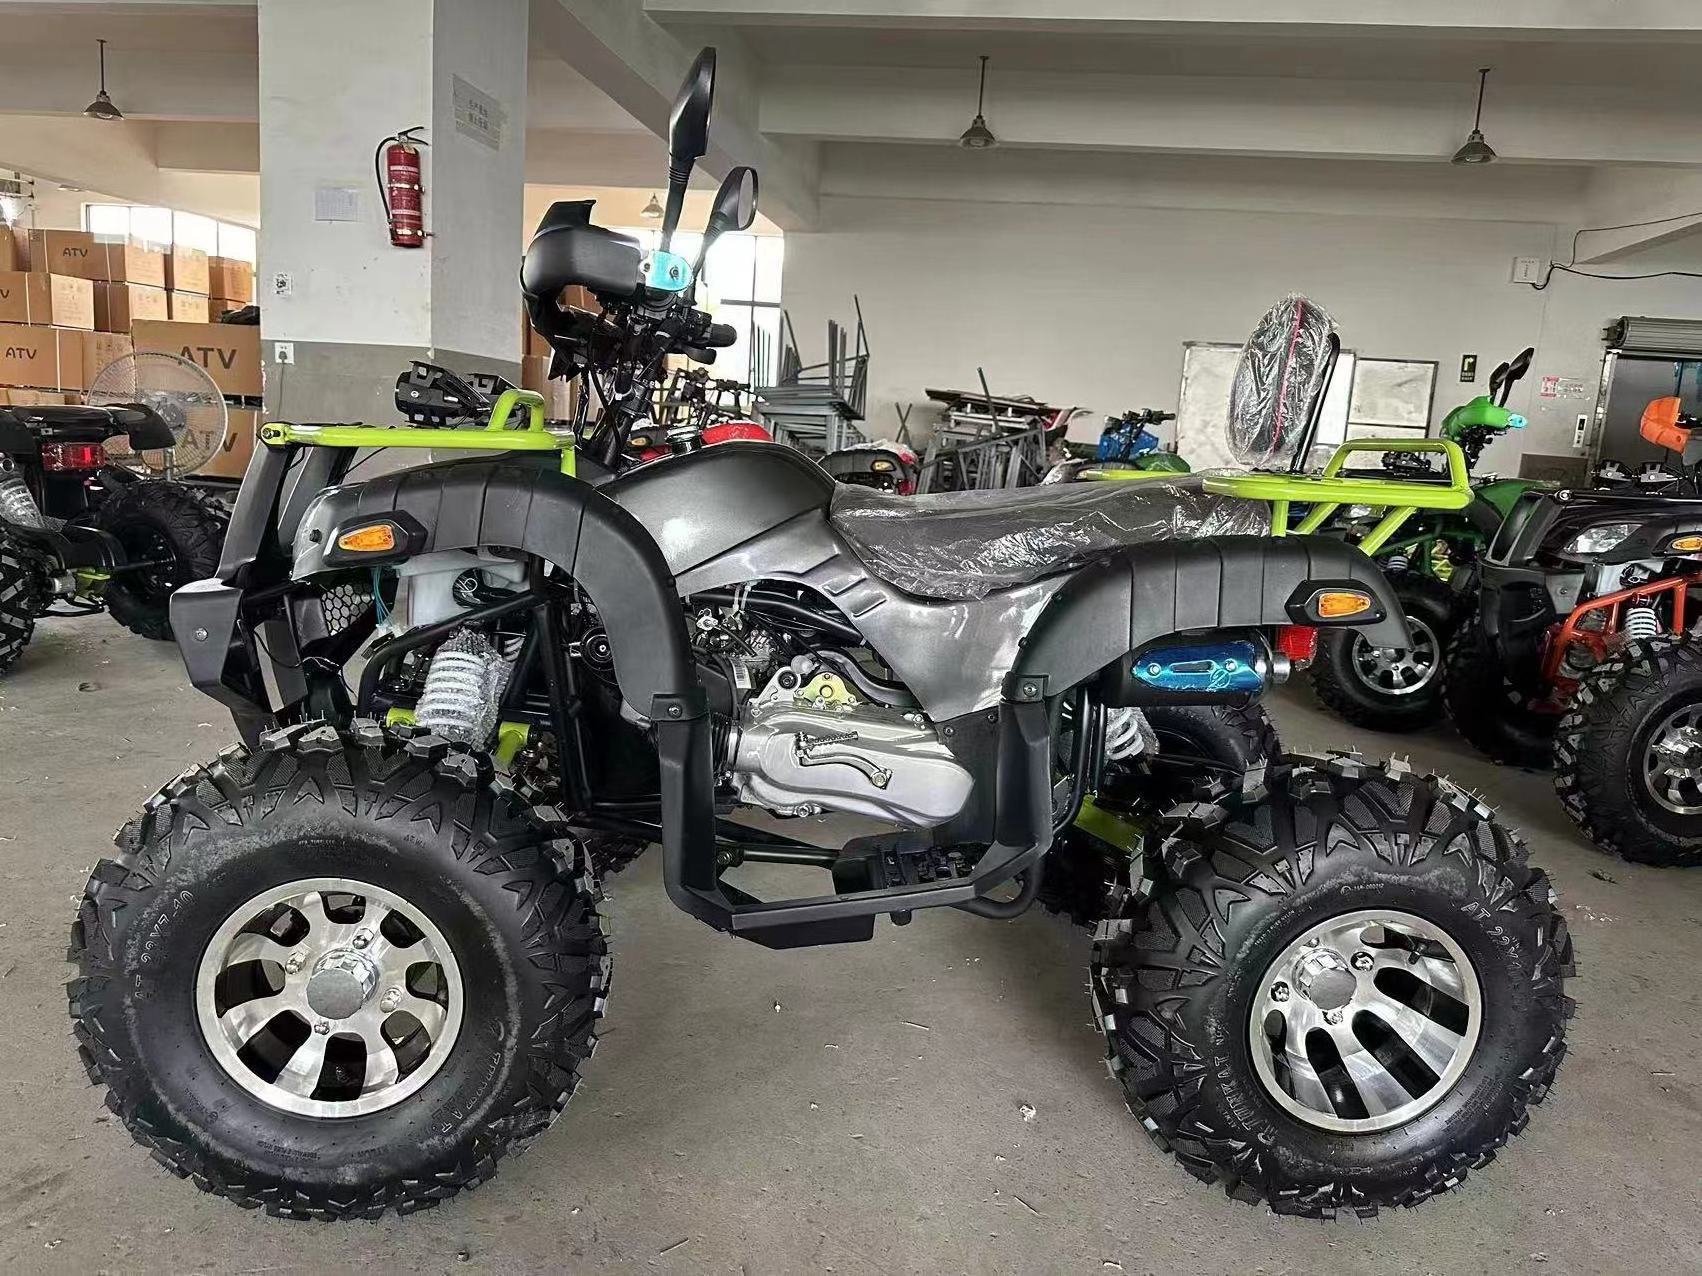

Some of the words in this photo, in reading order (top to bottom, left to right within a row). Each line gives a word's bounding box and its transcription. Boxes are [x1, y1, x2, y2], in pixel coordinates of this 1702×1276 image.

[62, 247, 88, 258] ATV
[5, 347, 37, 360] ATV
[180, 346, 237, 370] ATV
[182, 429, 238, 453] ATV
